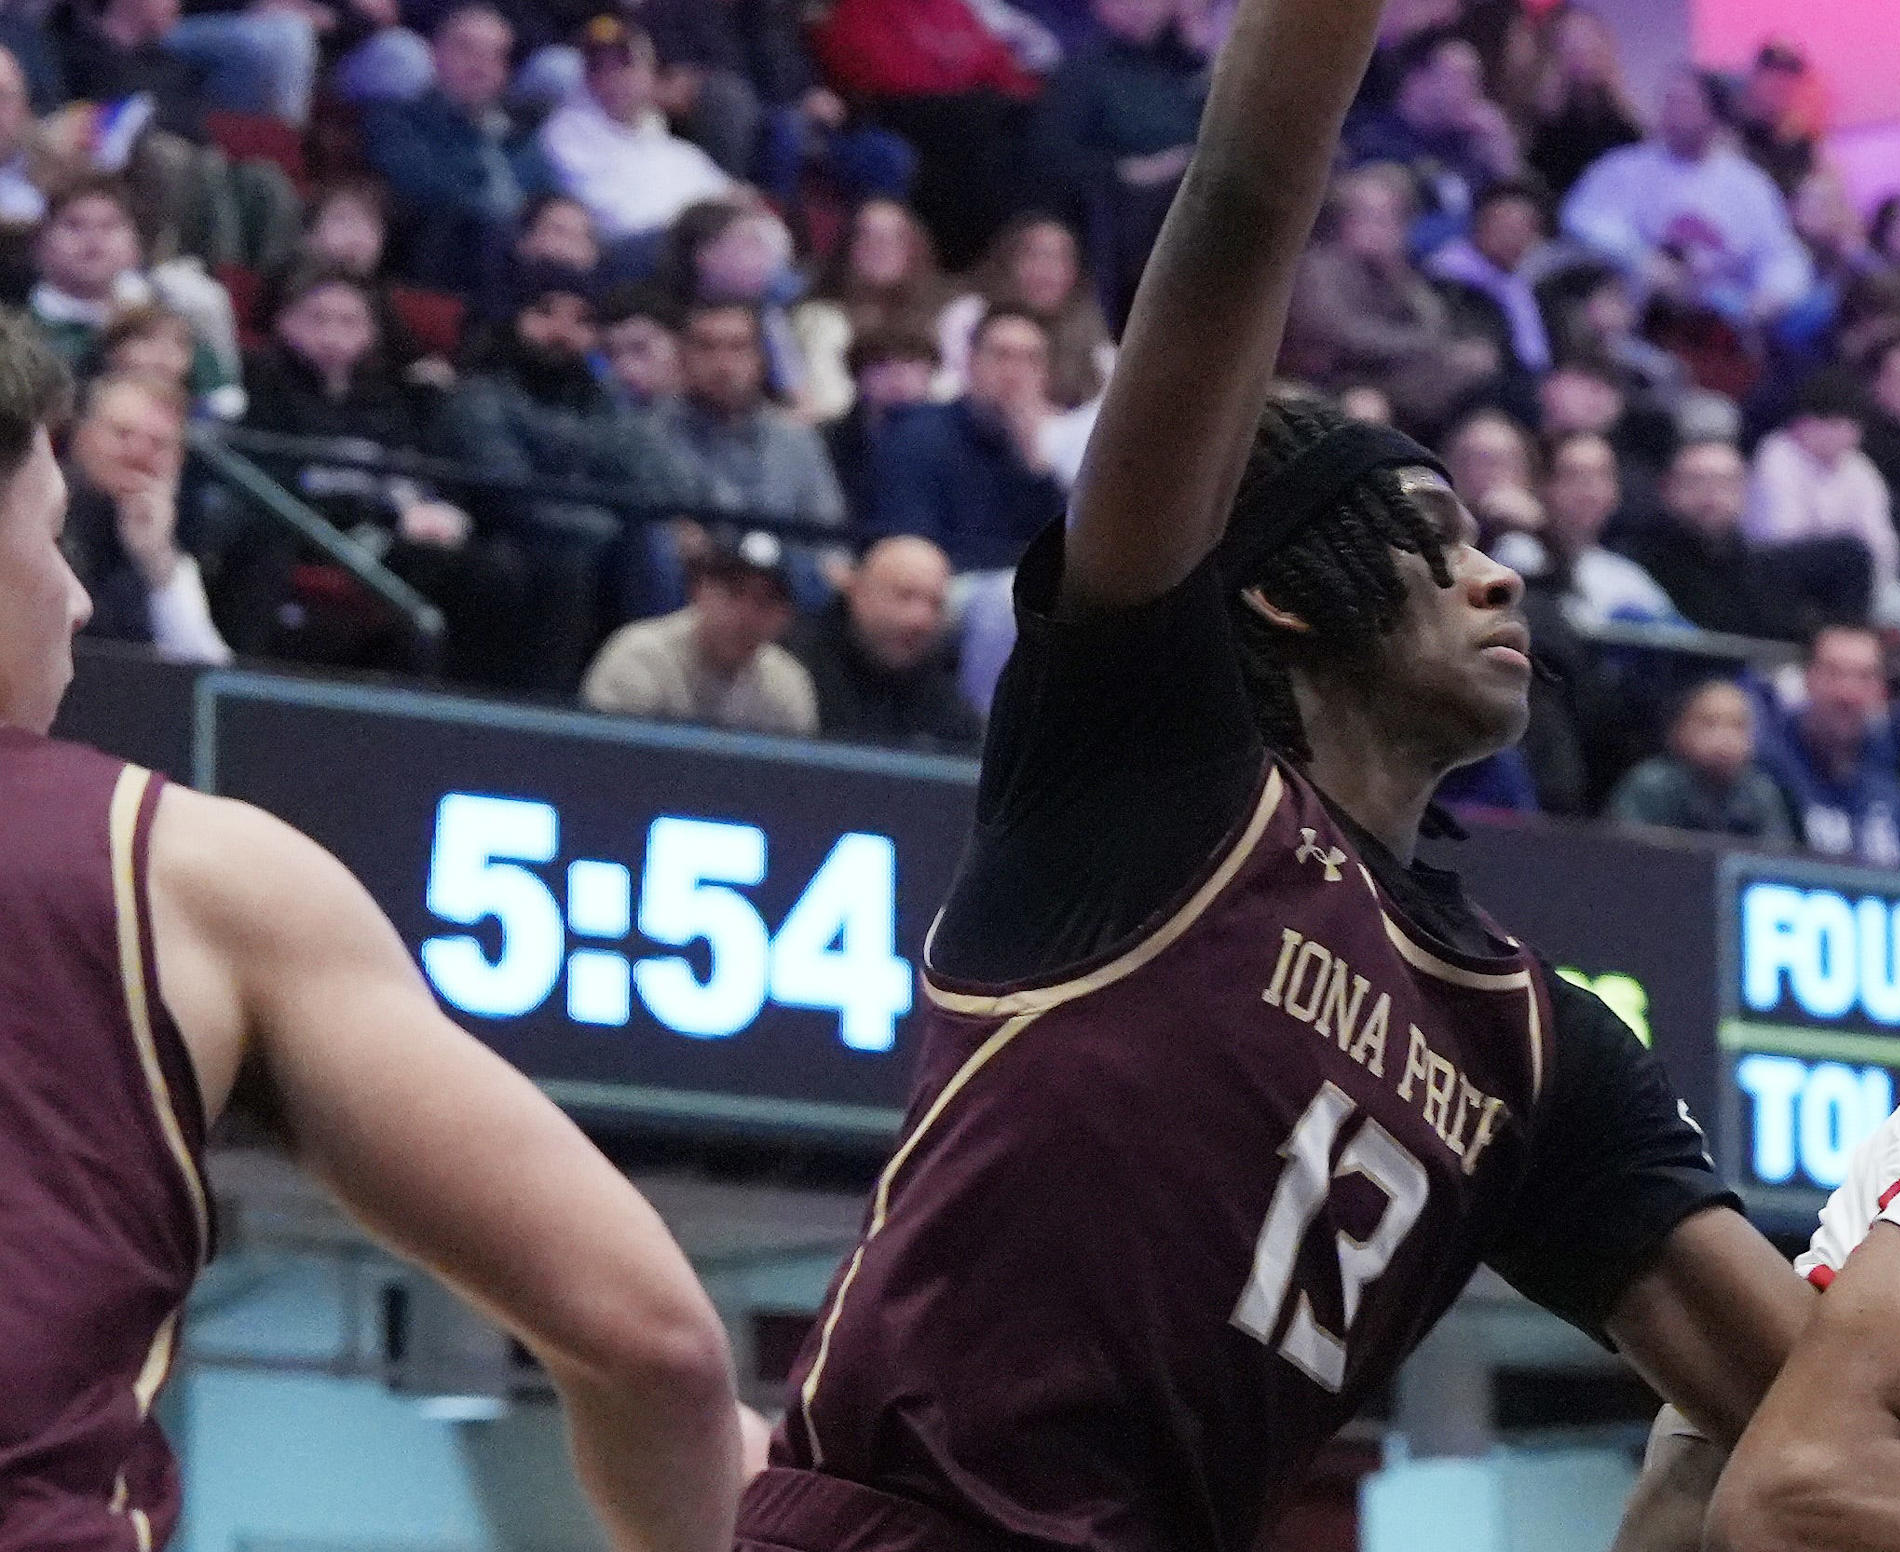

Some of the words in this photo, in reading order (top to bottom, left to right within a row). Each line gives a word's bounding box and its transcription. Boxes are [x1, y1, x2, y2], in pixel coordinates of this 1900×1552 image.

[420, 790, 913, 1053] 5:54
[1261, 926, 1394, 1079] IONA
[1228, 1079, 1429, 1394] 13
